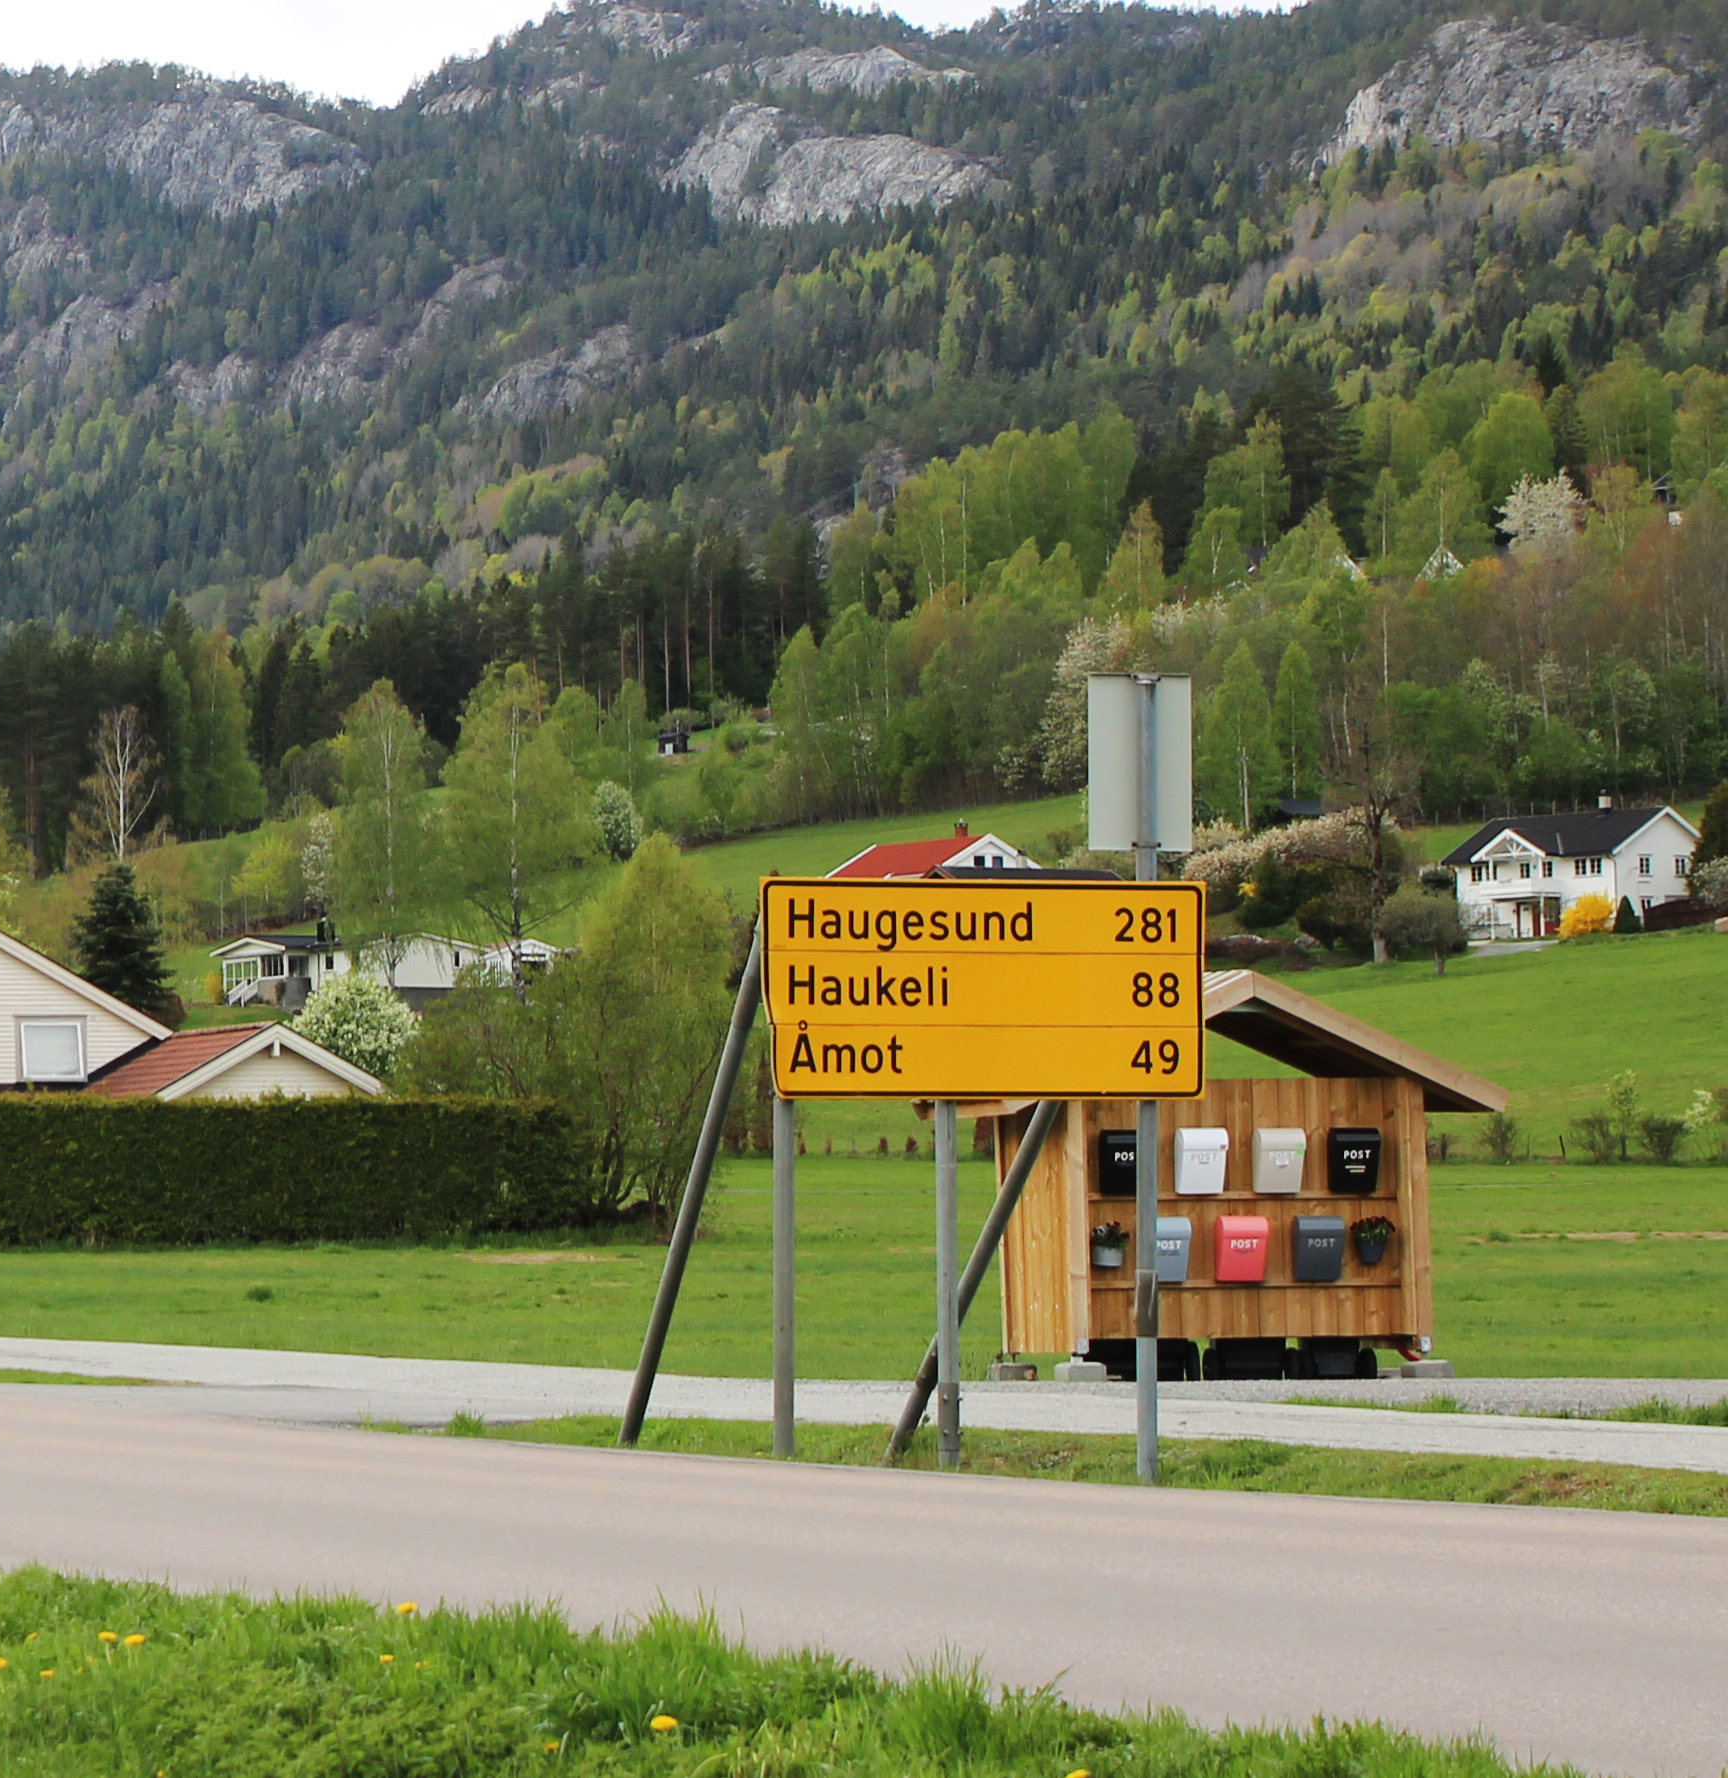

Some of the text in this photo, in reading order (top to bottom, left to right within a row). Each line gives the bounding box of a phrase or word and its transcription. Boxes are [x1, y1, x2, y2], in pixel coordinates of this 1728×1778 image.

[788, 898, 1178, 952] Haugesund 281
[788, 965, 1181, 1008] Haukeli 88
[789, 1020, 1180, 1075] Åmot 49
[1114, 1151, 1135, 1161] POS
[1190, 1152, 1218, 1162] POST
[1268, 1151, 1296, 1160] POST
[1343, 1149, 1371, 1159] POST
[1230, 1238, 1258, 1249] POST
[1307, 1238, 1335, 1248] POST
